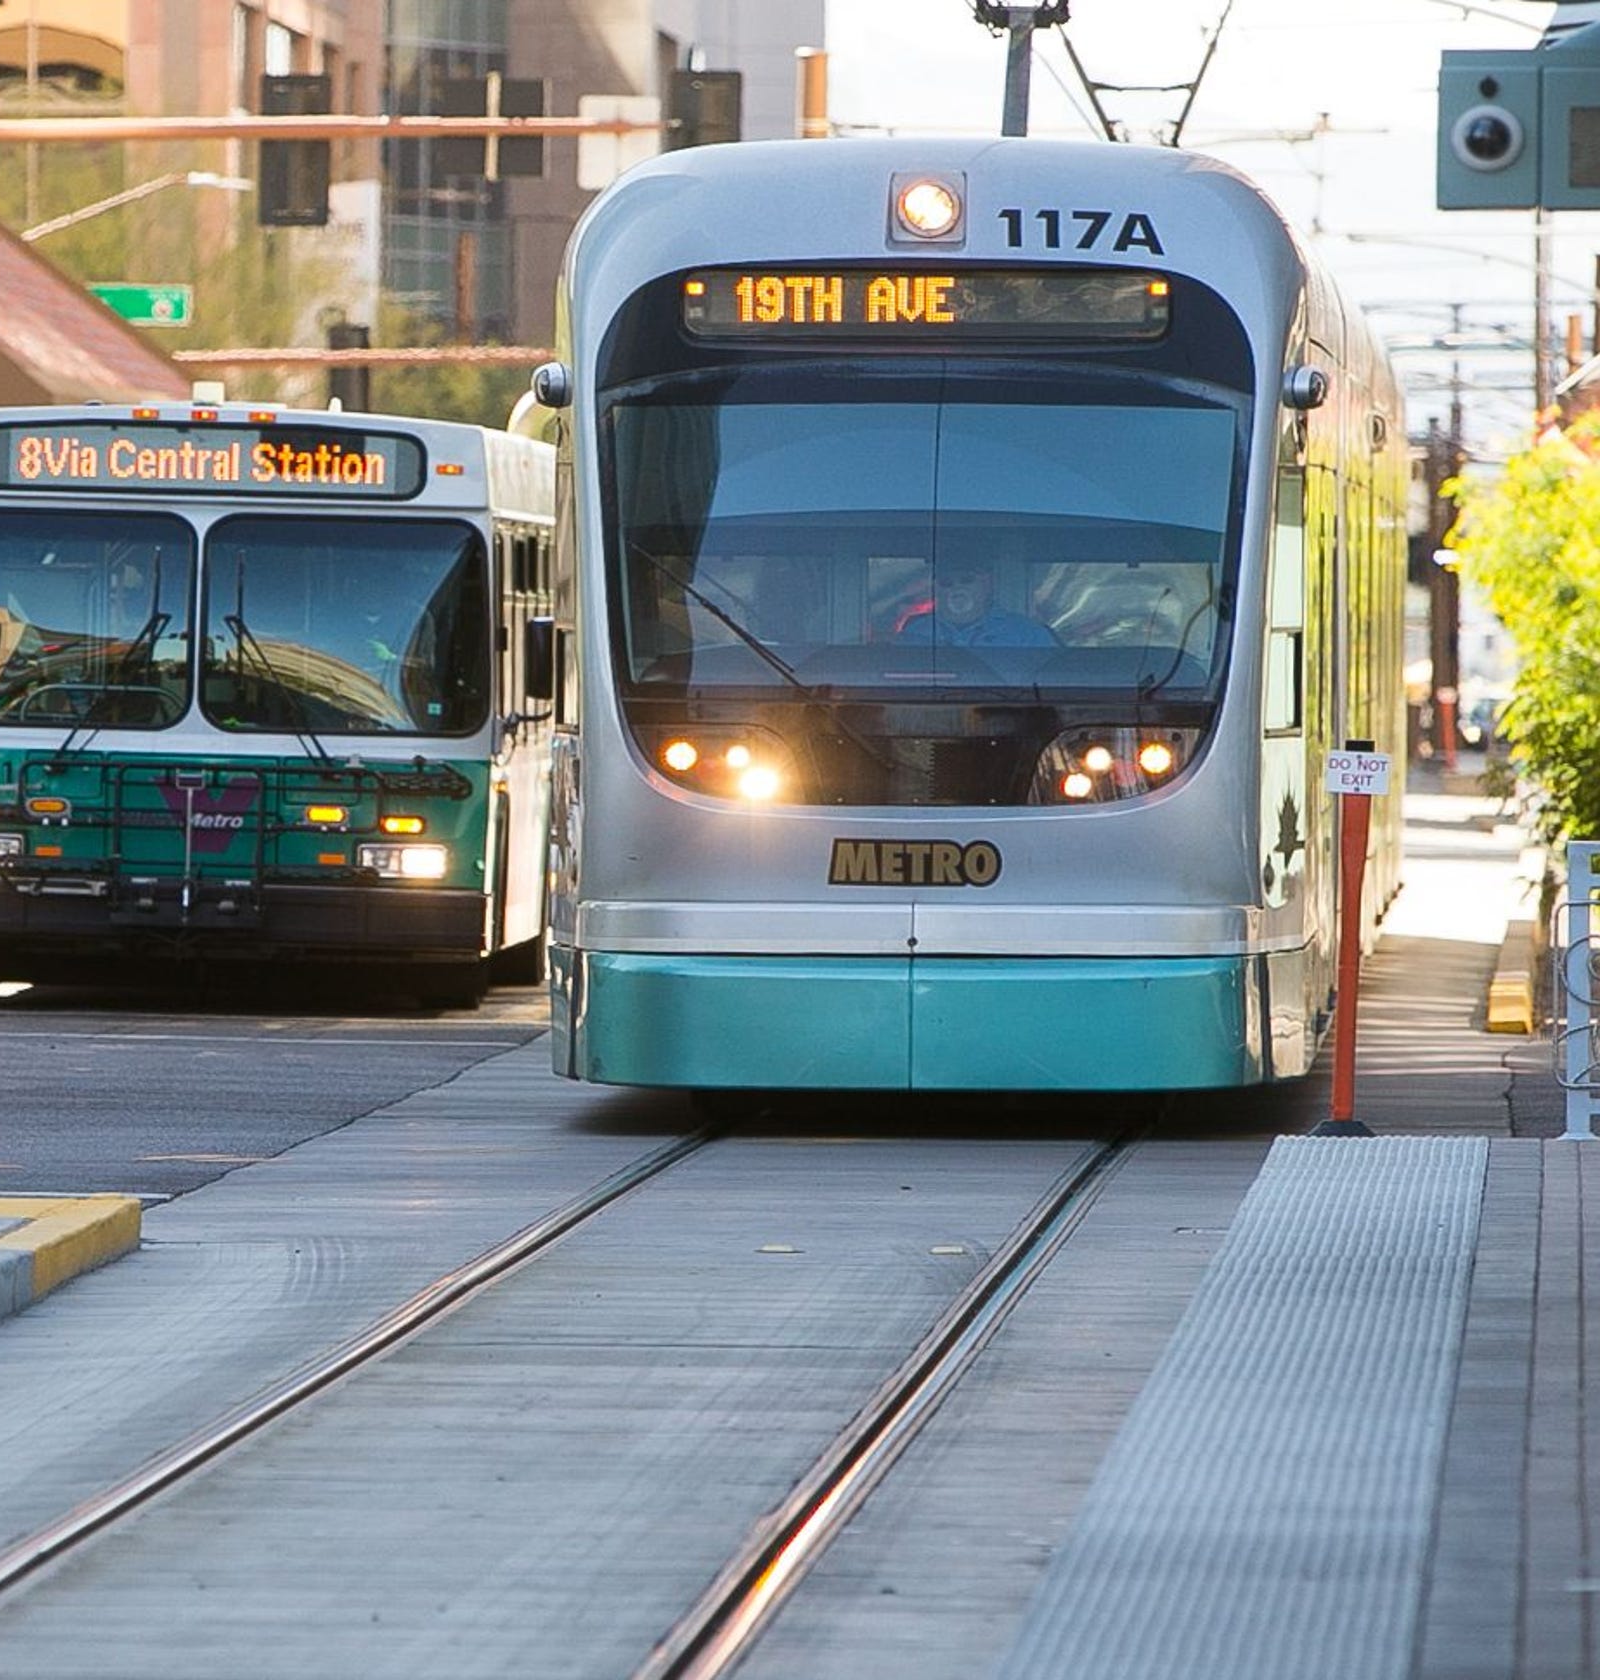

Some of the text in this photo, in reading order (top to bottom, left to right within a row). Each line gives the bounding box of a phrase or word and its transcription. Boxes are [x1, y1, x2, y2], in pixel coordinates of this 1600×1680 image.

[997, 208, 1165, 256] 117A
[735, 276, 955, 323] 19TH AVE
[108, 438, 240, 481] Central
[251, 443, 385, 485] Station
[1329, 758, 1388, 772] DO NOT
[1342, 774, 1373, 786] EXIT
[830, 840, 1001, 885] METRO
